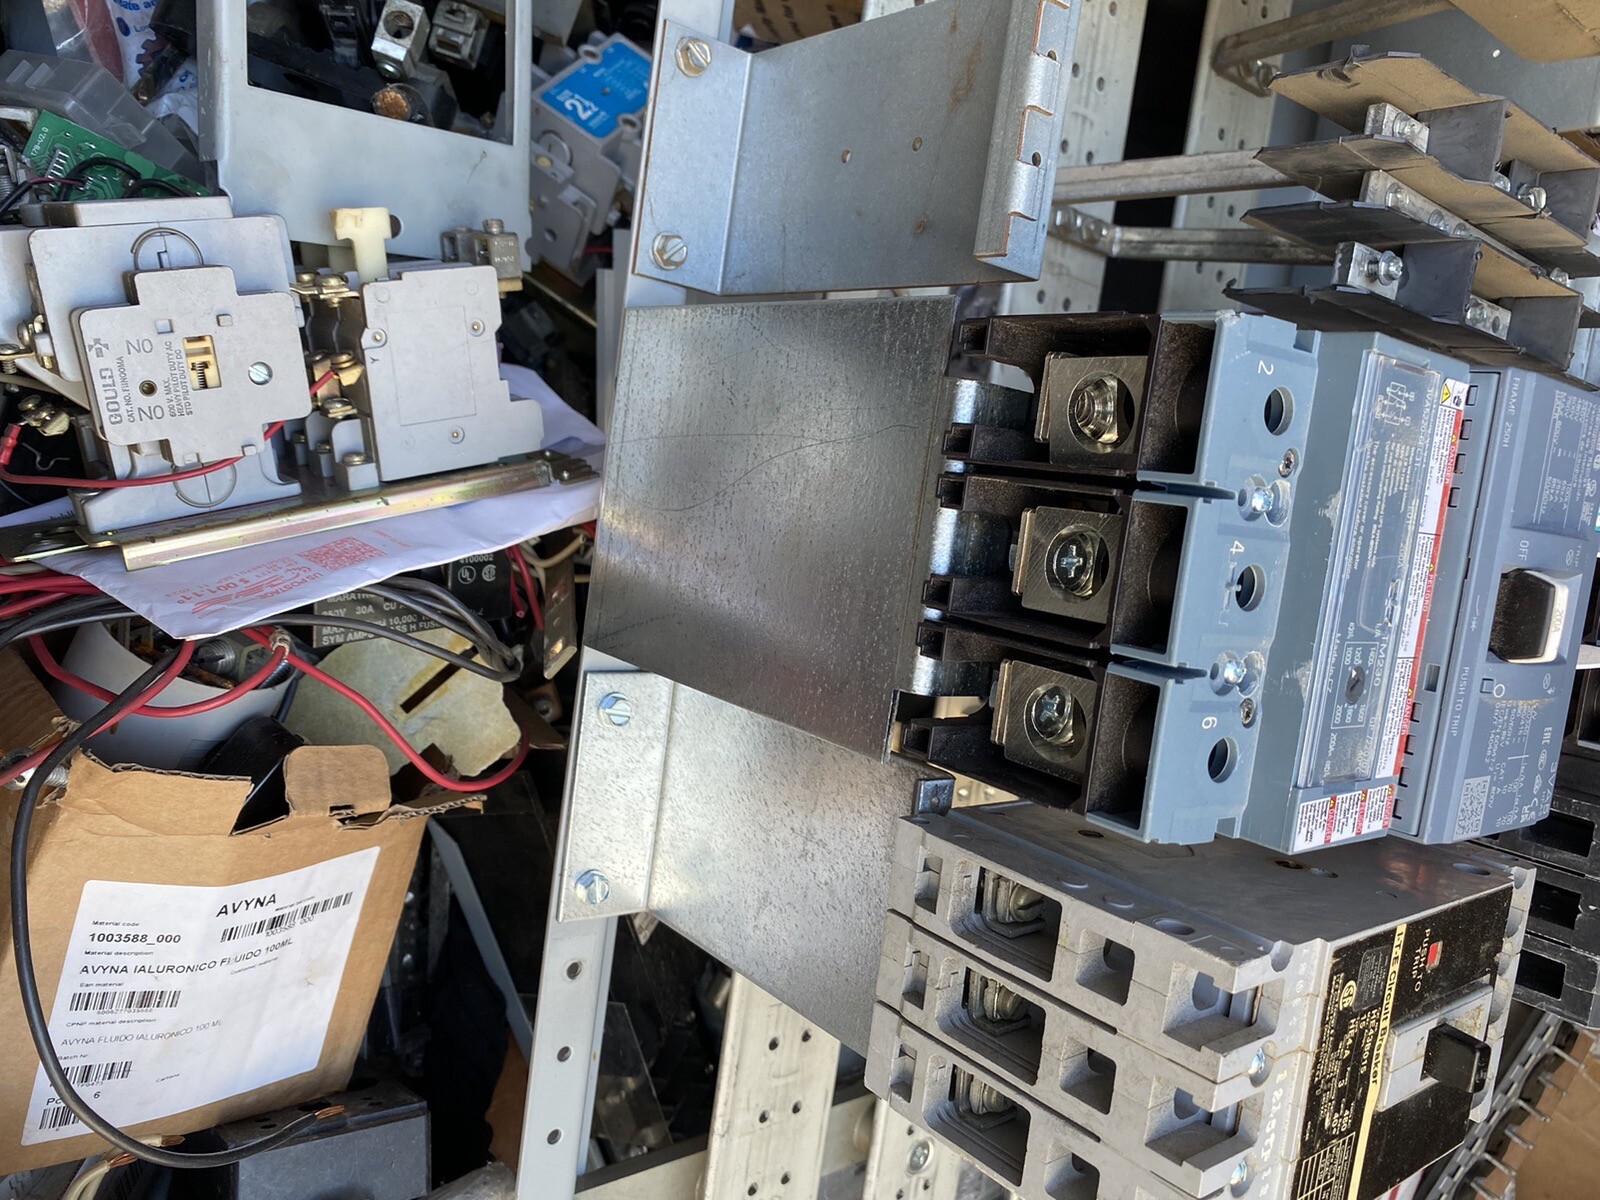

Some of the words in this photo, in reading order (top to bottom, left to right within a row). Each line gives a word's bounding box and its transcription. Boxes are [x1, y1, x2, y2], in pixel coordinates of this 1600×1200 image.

[100, 368, 122, 424] GOULD
[1508, 378, 1520, 414] FRAME
[1518, 540, 1529, 560] OFF
[355, 604, 374, 615] 30A
[1459, 667, 1469, 694] PUSH
[1455, 698, 1463, 710] TO
[1451, 716, 1460, 736] TRIP
[216, 893, 277, 918] AVYNA
[88, 932, 182, 946] 1003588_000
[1419, 929, 1430, 967] PUSH
[79, 965, 128, 974] AVYNA
[133, 961, 217, 974] IALURONICO
[1412, 947, 1421, 978] TRIP
[1415, 971, 1422, 991] TO
[60, 1038, 95, 1046] AVYNA
[98, 1034, 134, 1044] FLUIDO
[1372, 1027, 1387, 1084] Breaker
[94, 1090, 101, 1099] 6
